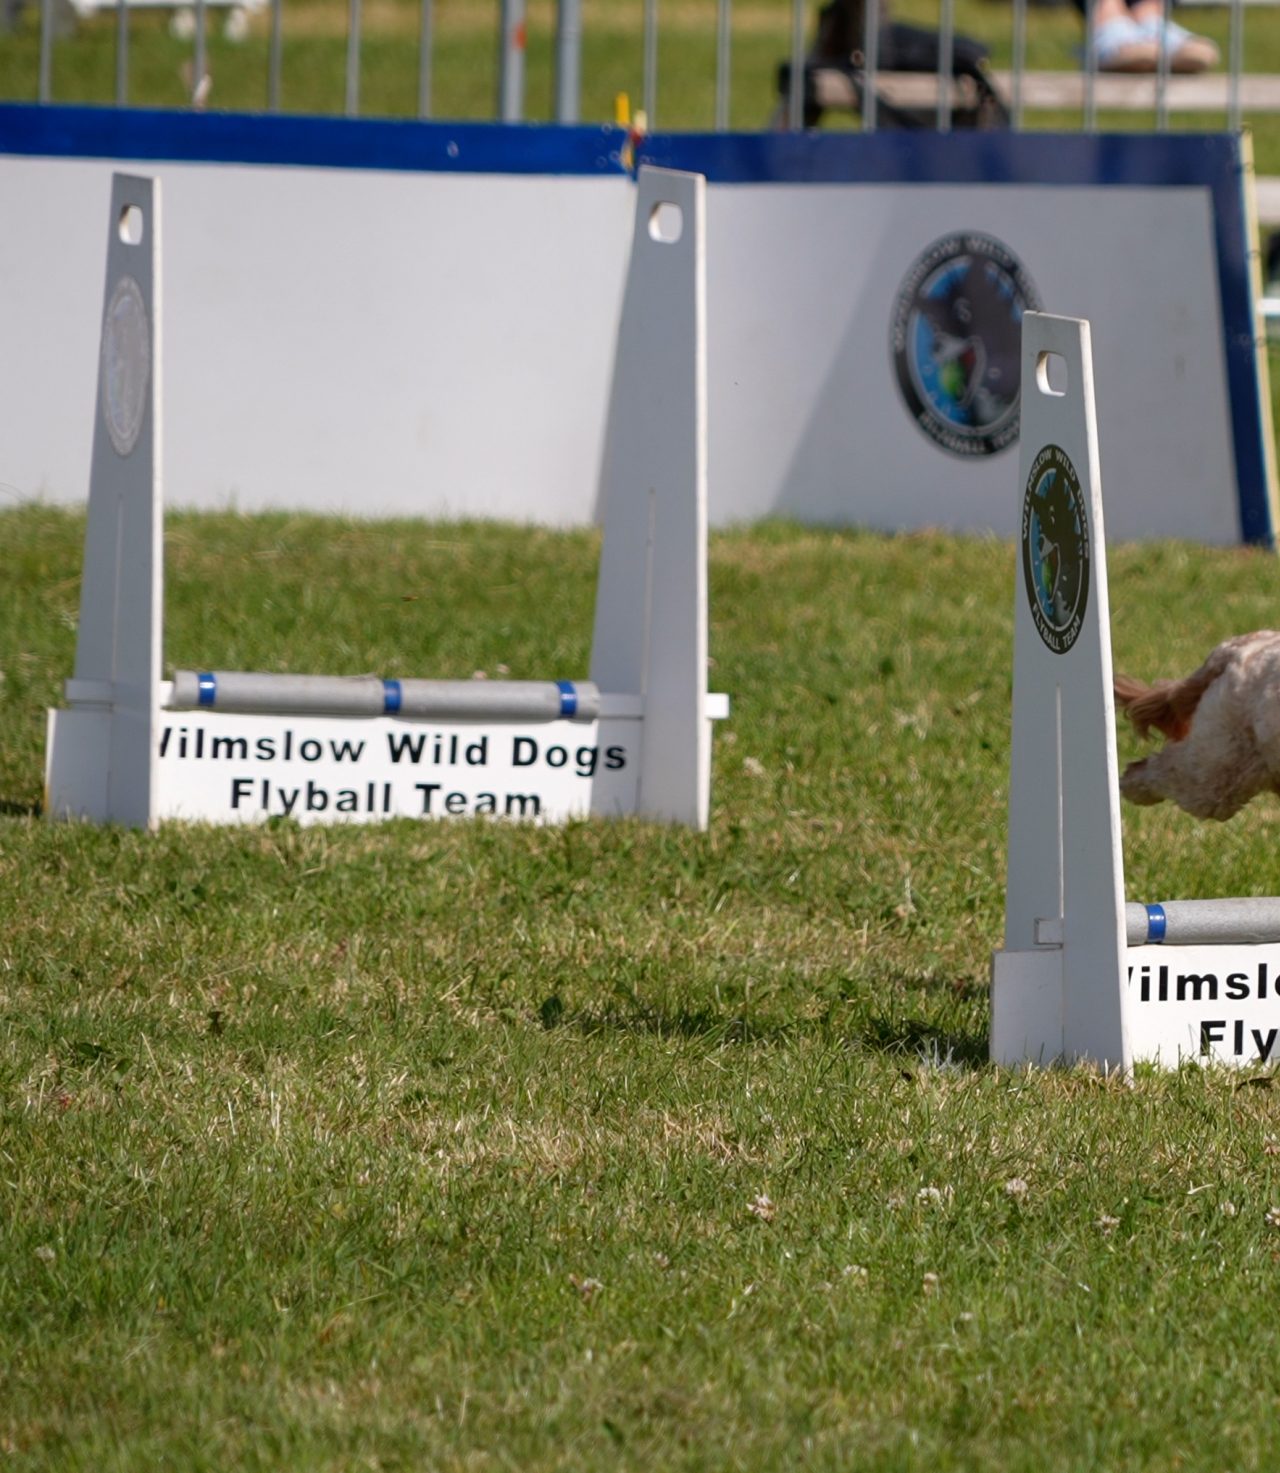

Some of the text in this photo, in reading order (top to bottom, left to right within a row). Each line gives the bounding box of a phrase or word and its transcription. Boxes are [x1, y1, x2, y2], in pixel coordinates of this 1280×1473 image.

[1055, 448, 1077, 482] WILD
[1032, 602, 1081, 650] FLYBALL TEAM
[387, 732, 488, 766] Wild
[512, 736, 627, 777] Dogs
[231, 778, 541, 817] Flyball Team
